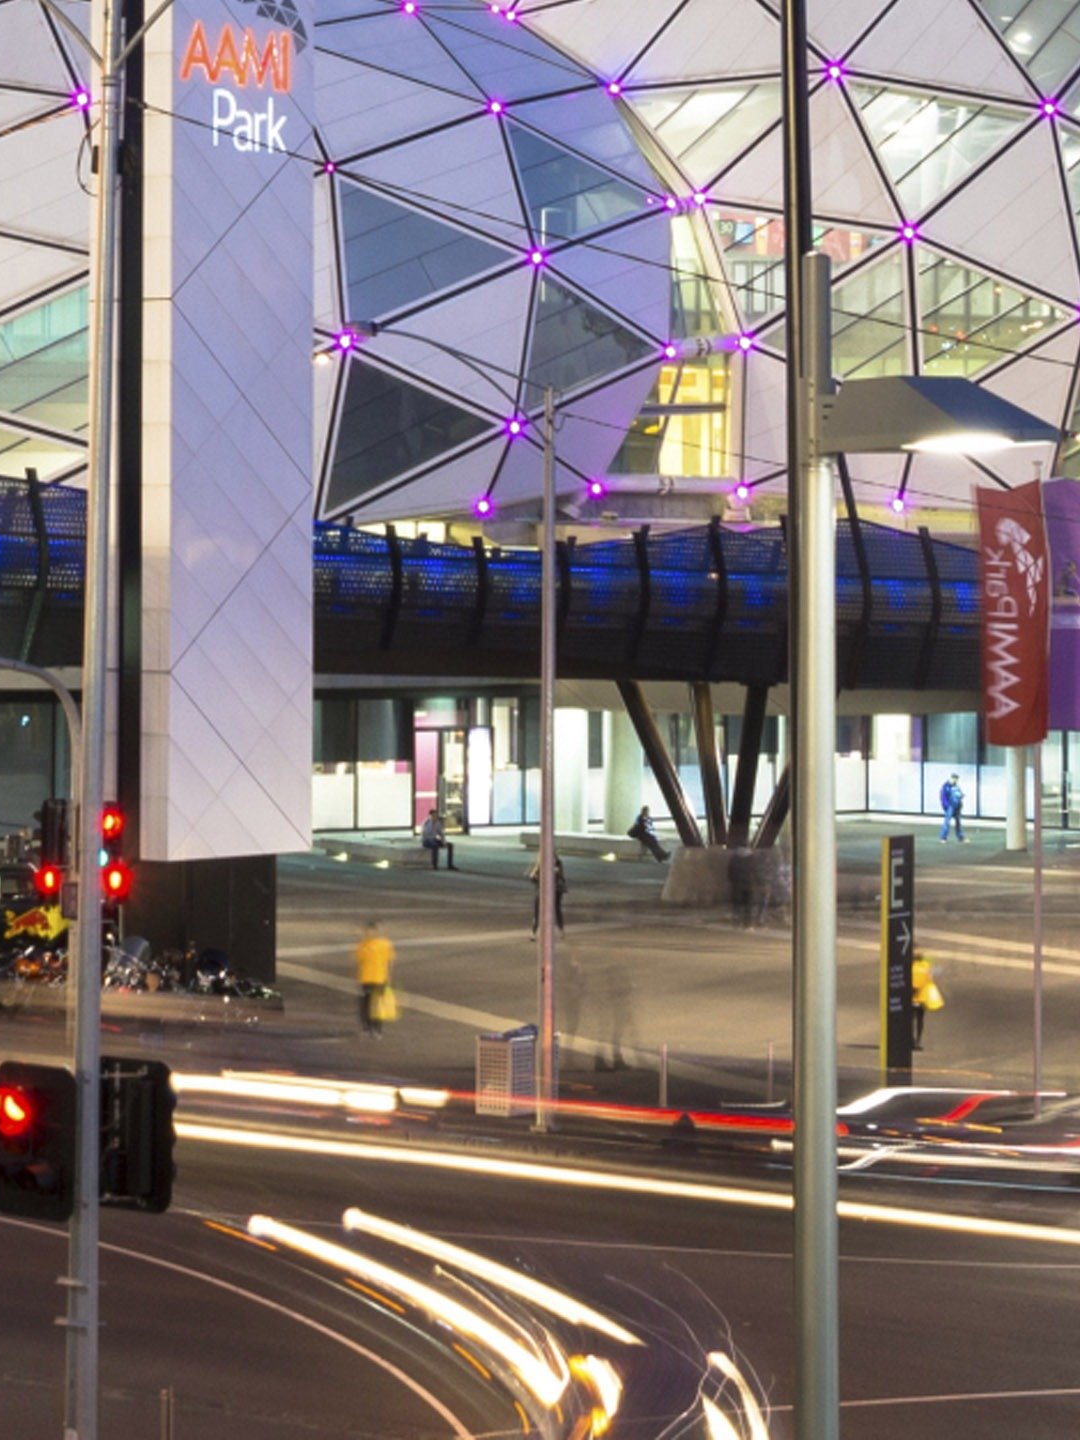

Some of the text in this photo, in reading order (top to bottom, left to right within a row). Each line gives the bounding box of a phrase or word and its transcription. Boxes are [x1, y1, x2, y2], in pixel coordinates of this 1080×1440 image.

[179, 20, 290, 93] AAMI
[212, 88, 287, 153] Park
[891, 857, 904, 908] E
